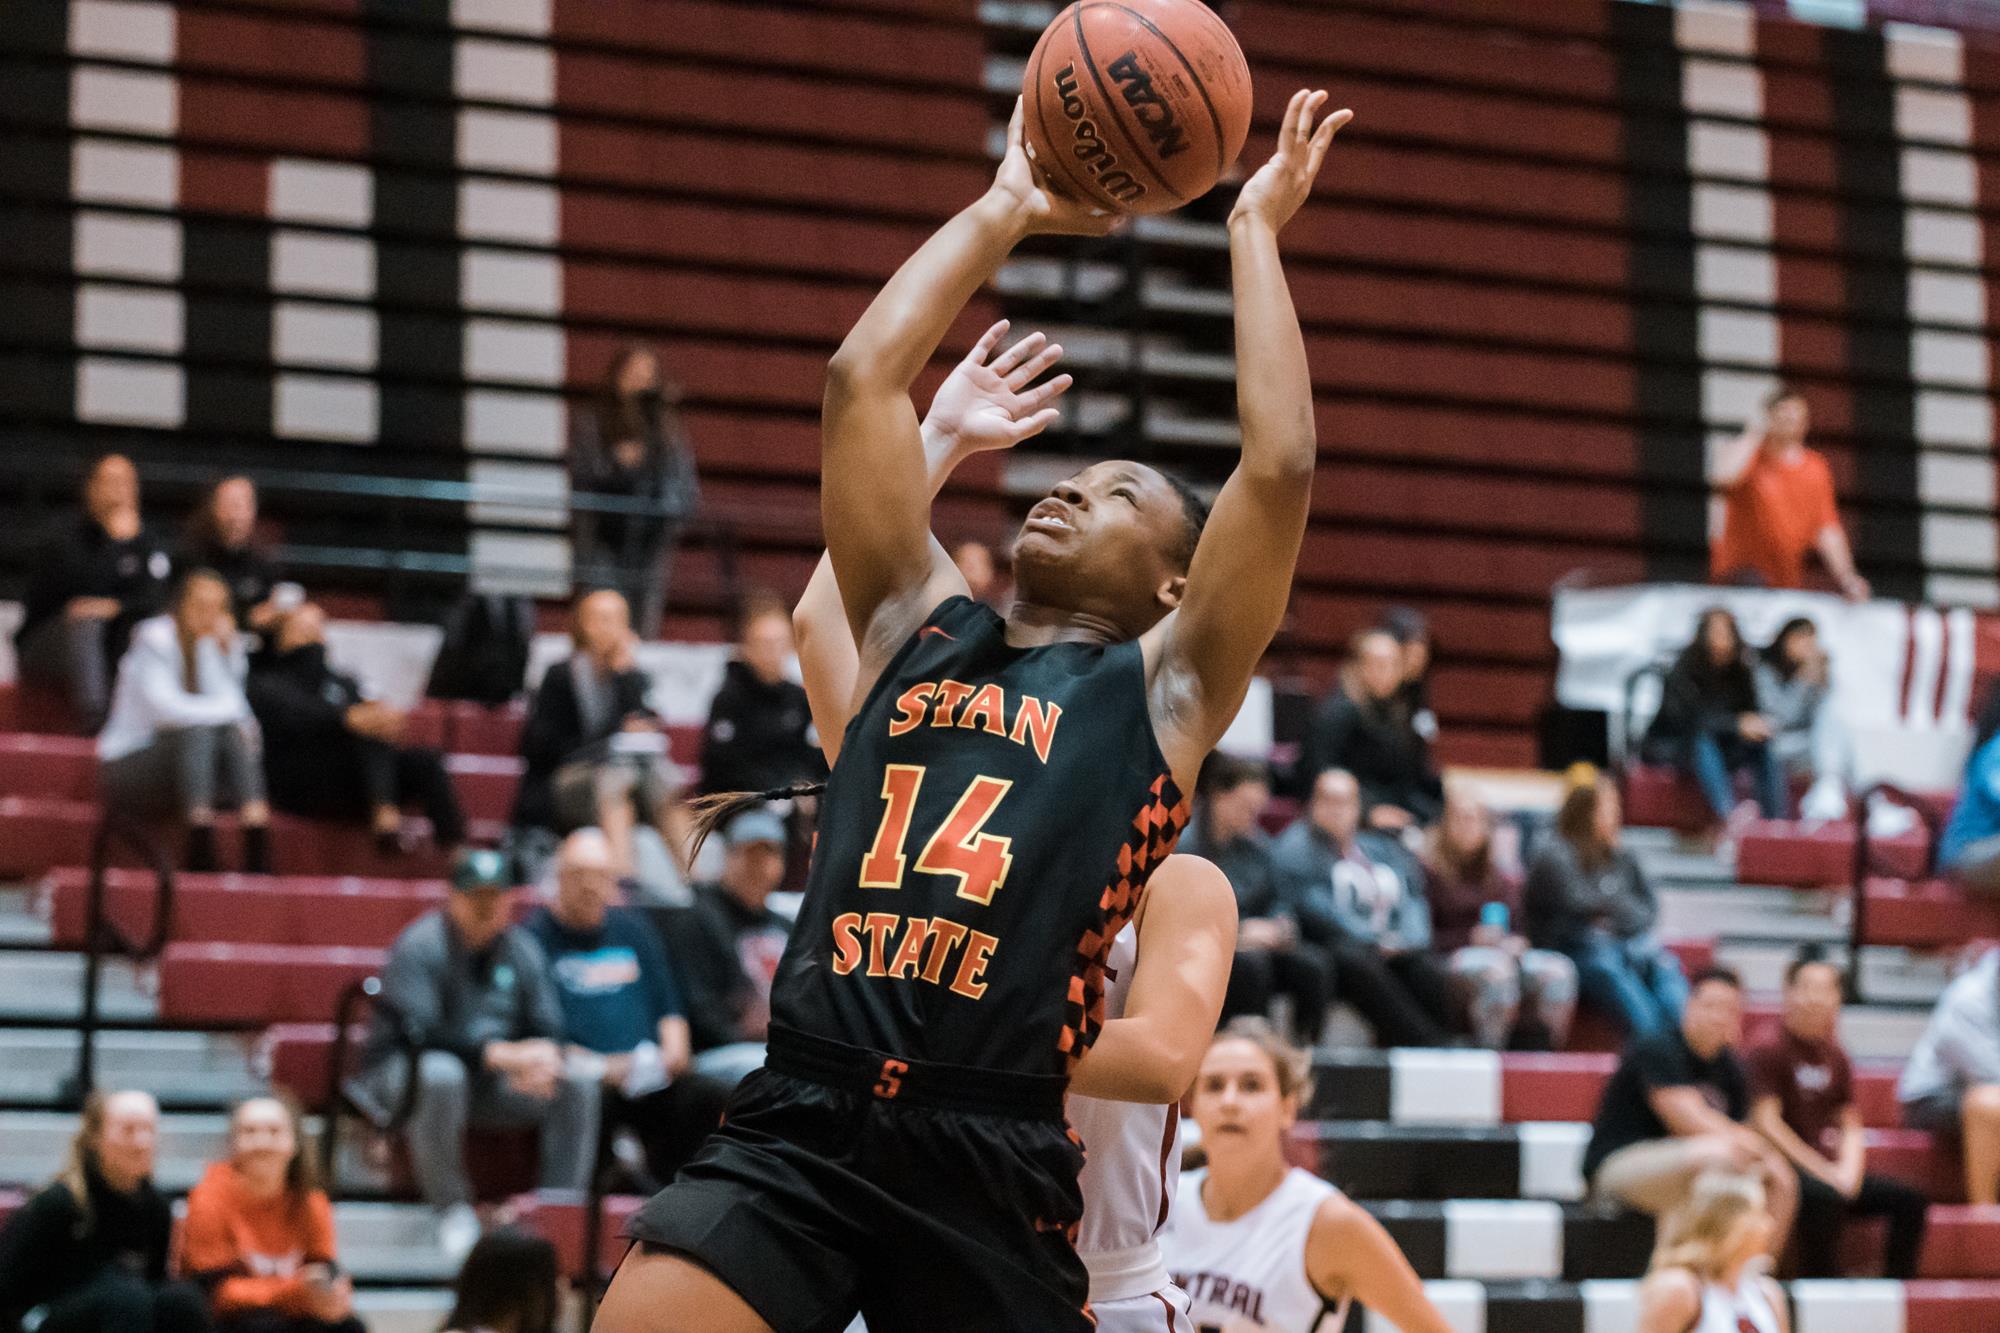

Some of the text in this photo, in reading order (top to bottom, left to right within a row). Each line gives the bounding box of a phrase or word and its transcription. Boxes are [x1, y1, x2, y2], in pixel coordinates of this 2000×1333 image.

[1054, 60, 1148, 201] Wilson
[1107, 50, 1190, 161] NCAA
[889, 678, 1063, 765] STAN
[858, 763, 1014, 907] 14
[832, 911, 999, 1000] STATE
